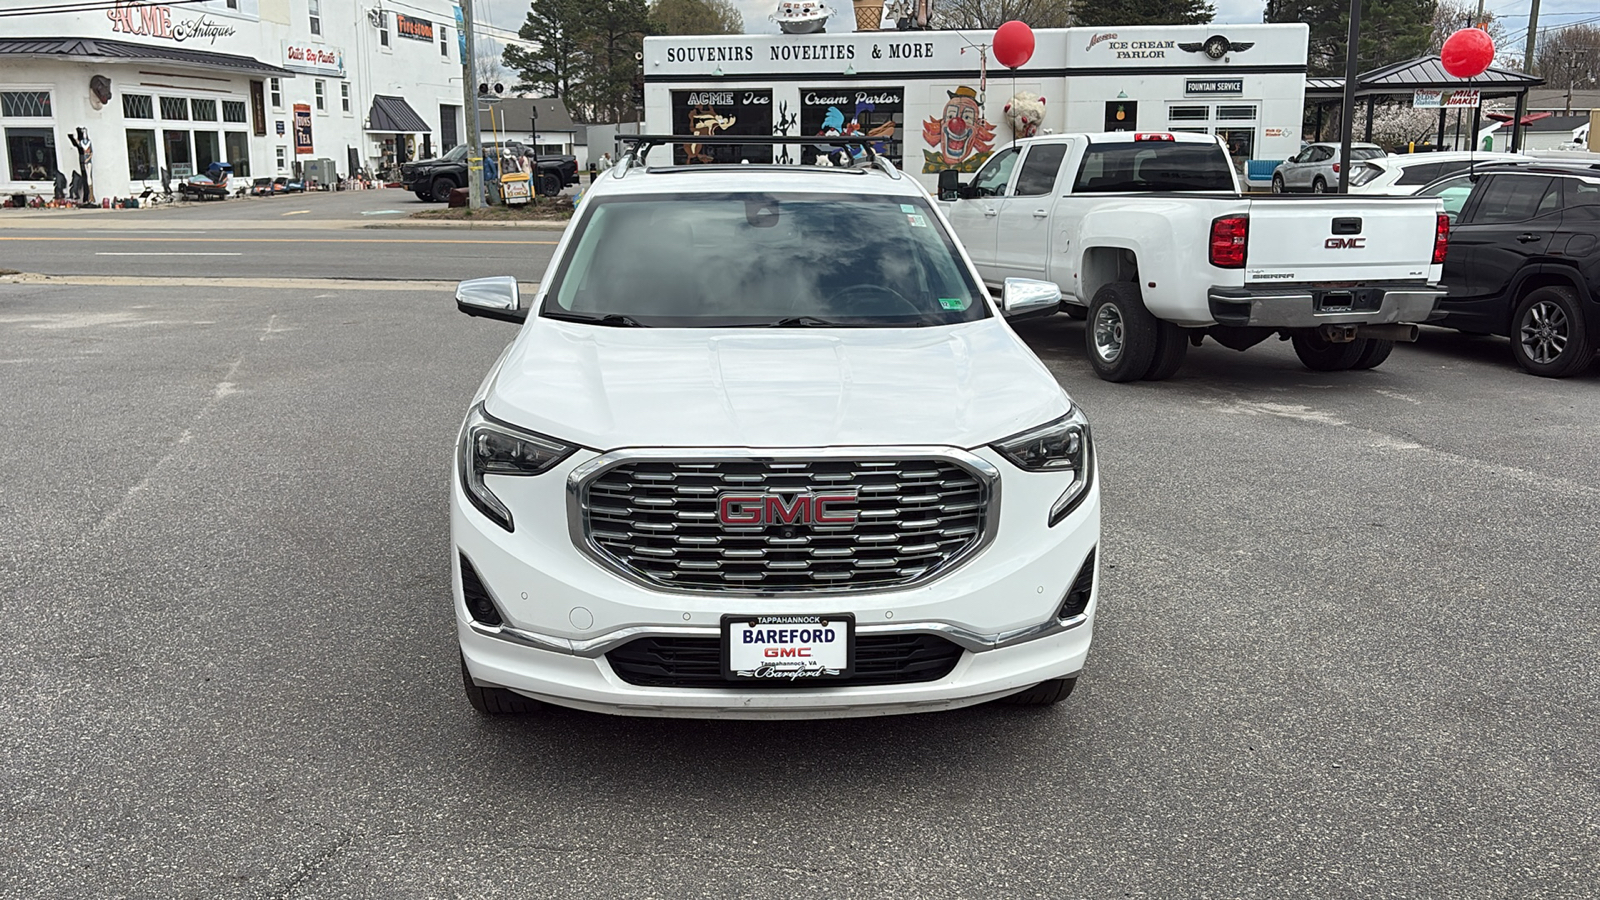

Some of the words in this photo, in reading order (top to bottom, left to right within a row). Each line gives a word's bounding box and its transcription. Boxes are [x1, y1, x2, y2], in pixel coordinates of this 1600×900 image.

[107, 0, 174, 39] ACME
[173, 14, 236, 45] Antiques
[1109, 41, 1129, 50] ICE
[1131, 40, 1175, 49] CREAM
[288, 46, 304, 60] Dutch
[306, 48, 317, 65] Boy
[318, 49, 335, 65] Paints
[667, 46, 754, 63] SOUVENIRS
[770, 44, 856, 61] NOVELTIES
[871, 44, 883, 60] &
[889, 43, 934, 59] MORE
[1116, 50, 1165, 59] PARLOR
[1187, 82, 1216, 91] FOUNTAIN
[1217, 82, 1241, 91] SERVICE
[687, 91, 734, 105] ACME
[742, 91, 770, 105] Ice
[804, 92, 849, 106] Cream
[855, 91, 901, 105] Parlor
[1453, 89, 1480, 98] MILK
[1446, 97, 1478, 106] SHAKES
[298, 132, 311, 145] TEA
[1324, 238, 1366, 249] GMC
[718, 491, 860, 526] GMC
[757, 616, 820, 624] TAPPAHANNOCK
[742, 629, 836, 644] BAREFORD
[764, 647, 813, 658] GMC
[754, 666, 825, 681] Bareford
